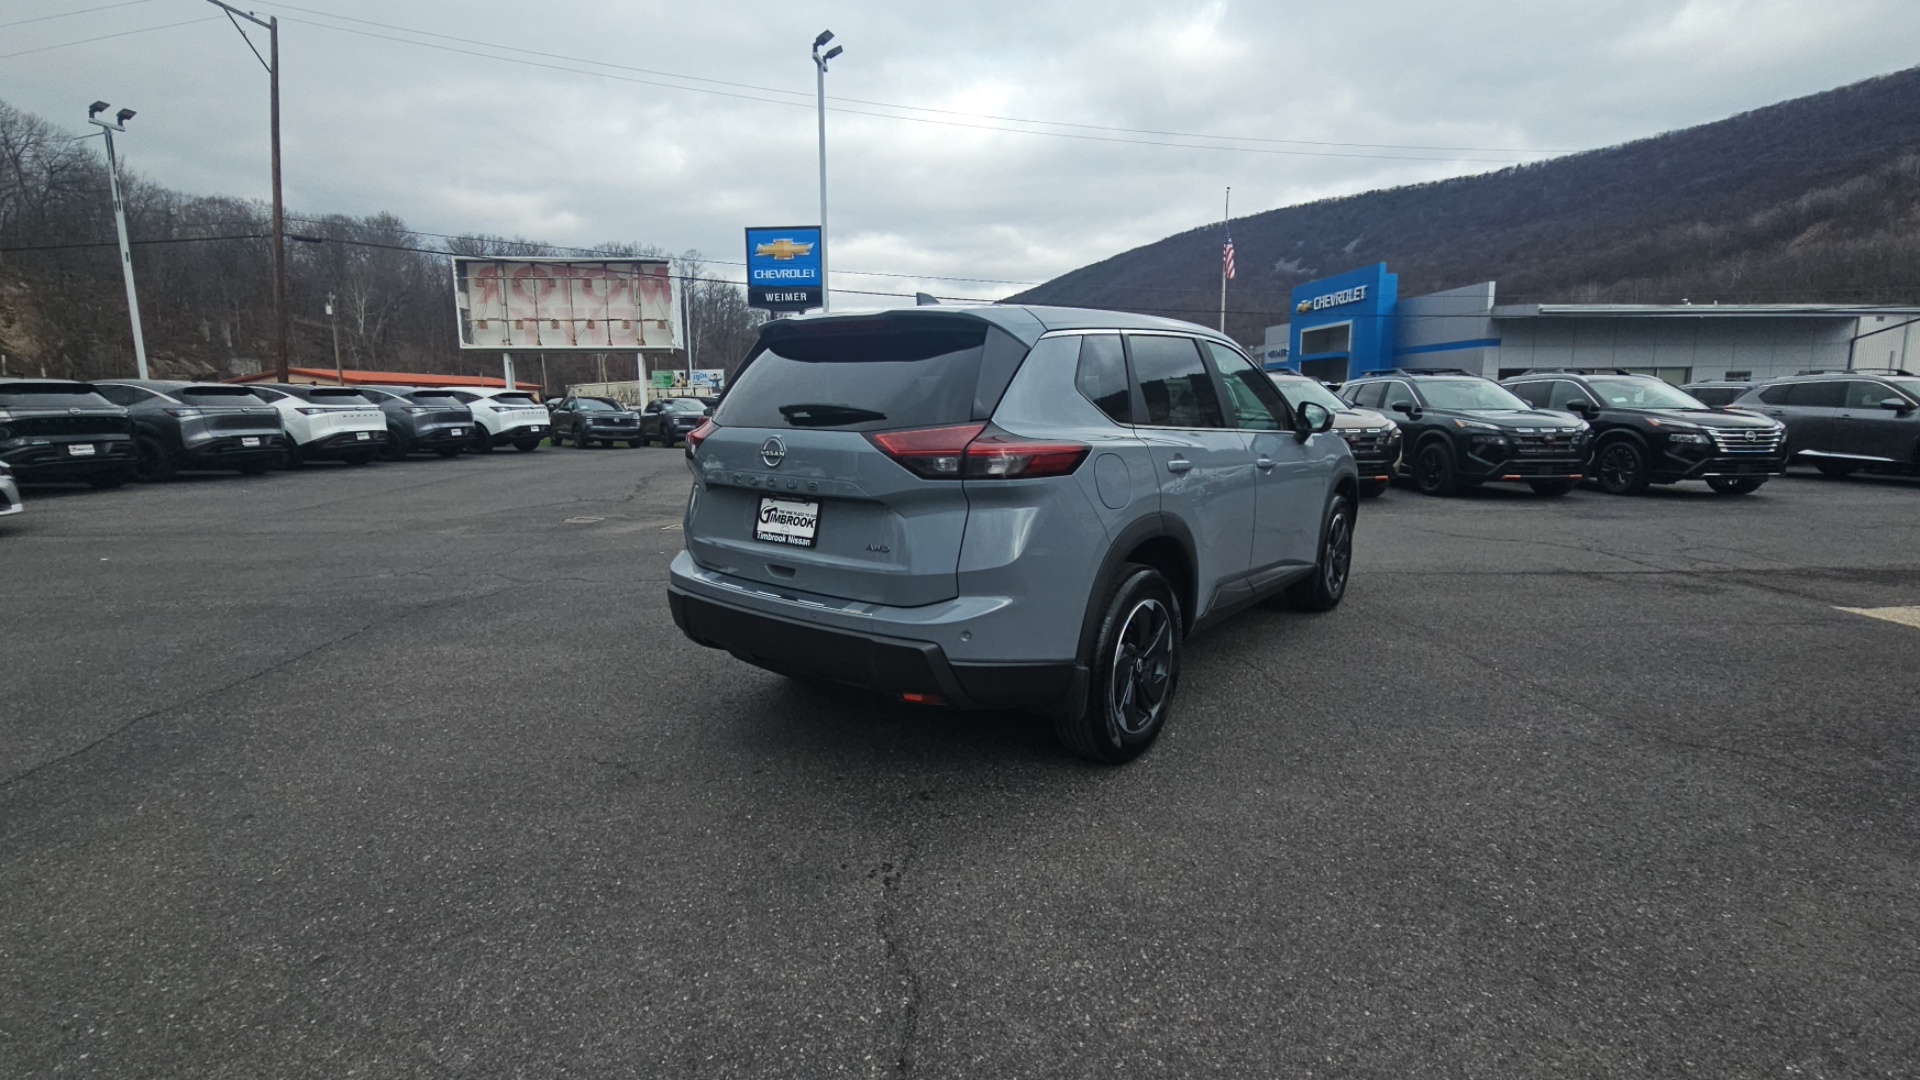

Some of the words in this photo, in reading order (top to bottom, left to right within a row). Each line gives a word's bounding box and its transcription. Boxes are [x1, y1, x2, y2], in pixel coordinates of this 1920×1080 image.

[754, 269, 815, 279] CHEVROLET
[765, 293, 807, 302] WEIMER
[1313, 285, 1368, 310] CHEVROLET
[760, 449, 785, 457] NISSAN
[734, 474, 817, 491] ROGUE
[759, 506, 817, 529] TIMBROOK
[756, 530, 787, 543] Timbrook
[787, 534, 811, 547] Nissan
